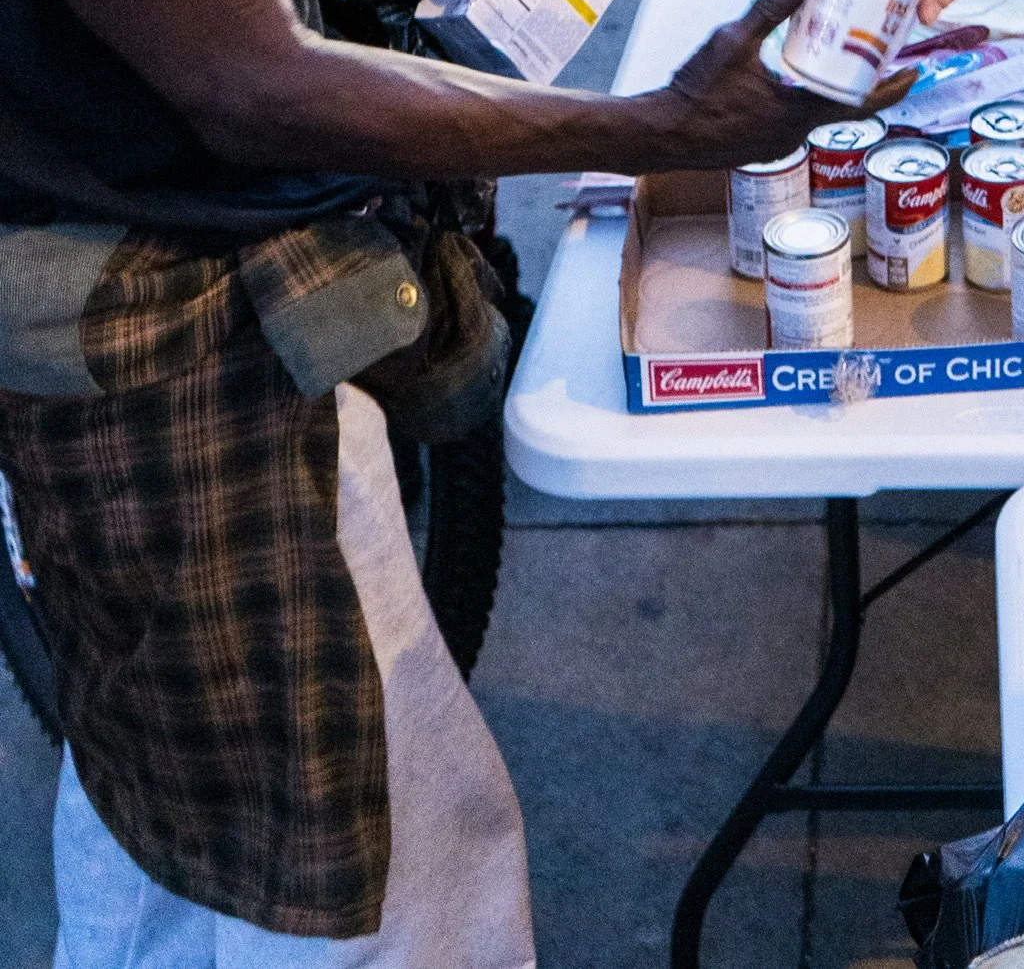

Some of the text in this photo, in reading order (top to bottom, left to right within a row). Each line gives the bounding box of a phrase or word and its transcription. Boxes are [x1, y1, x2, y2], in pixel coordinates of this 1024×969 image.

[660, 367, 753, 394] Campbell's
[772, 363, 881, 391] CREM
[894, 362, 936, 384] OF
